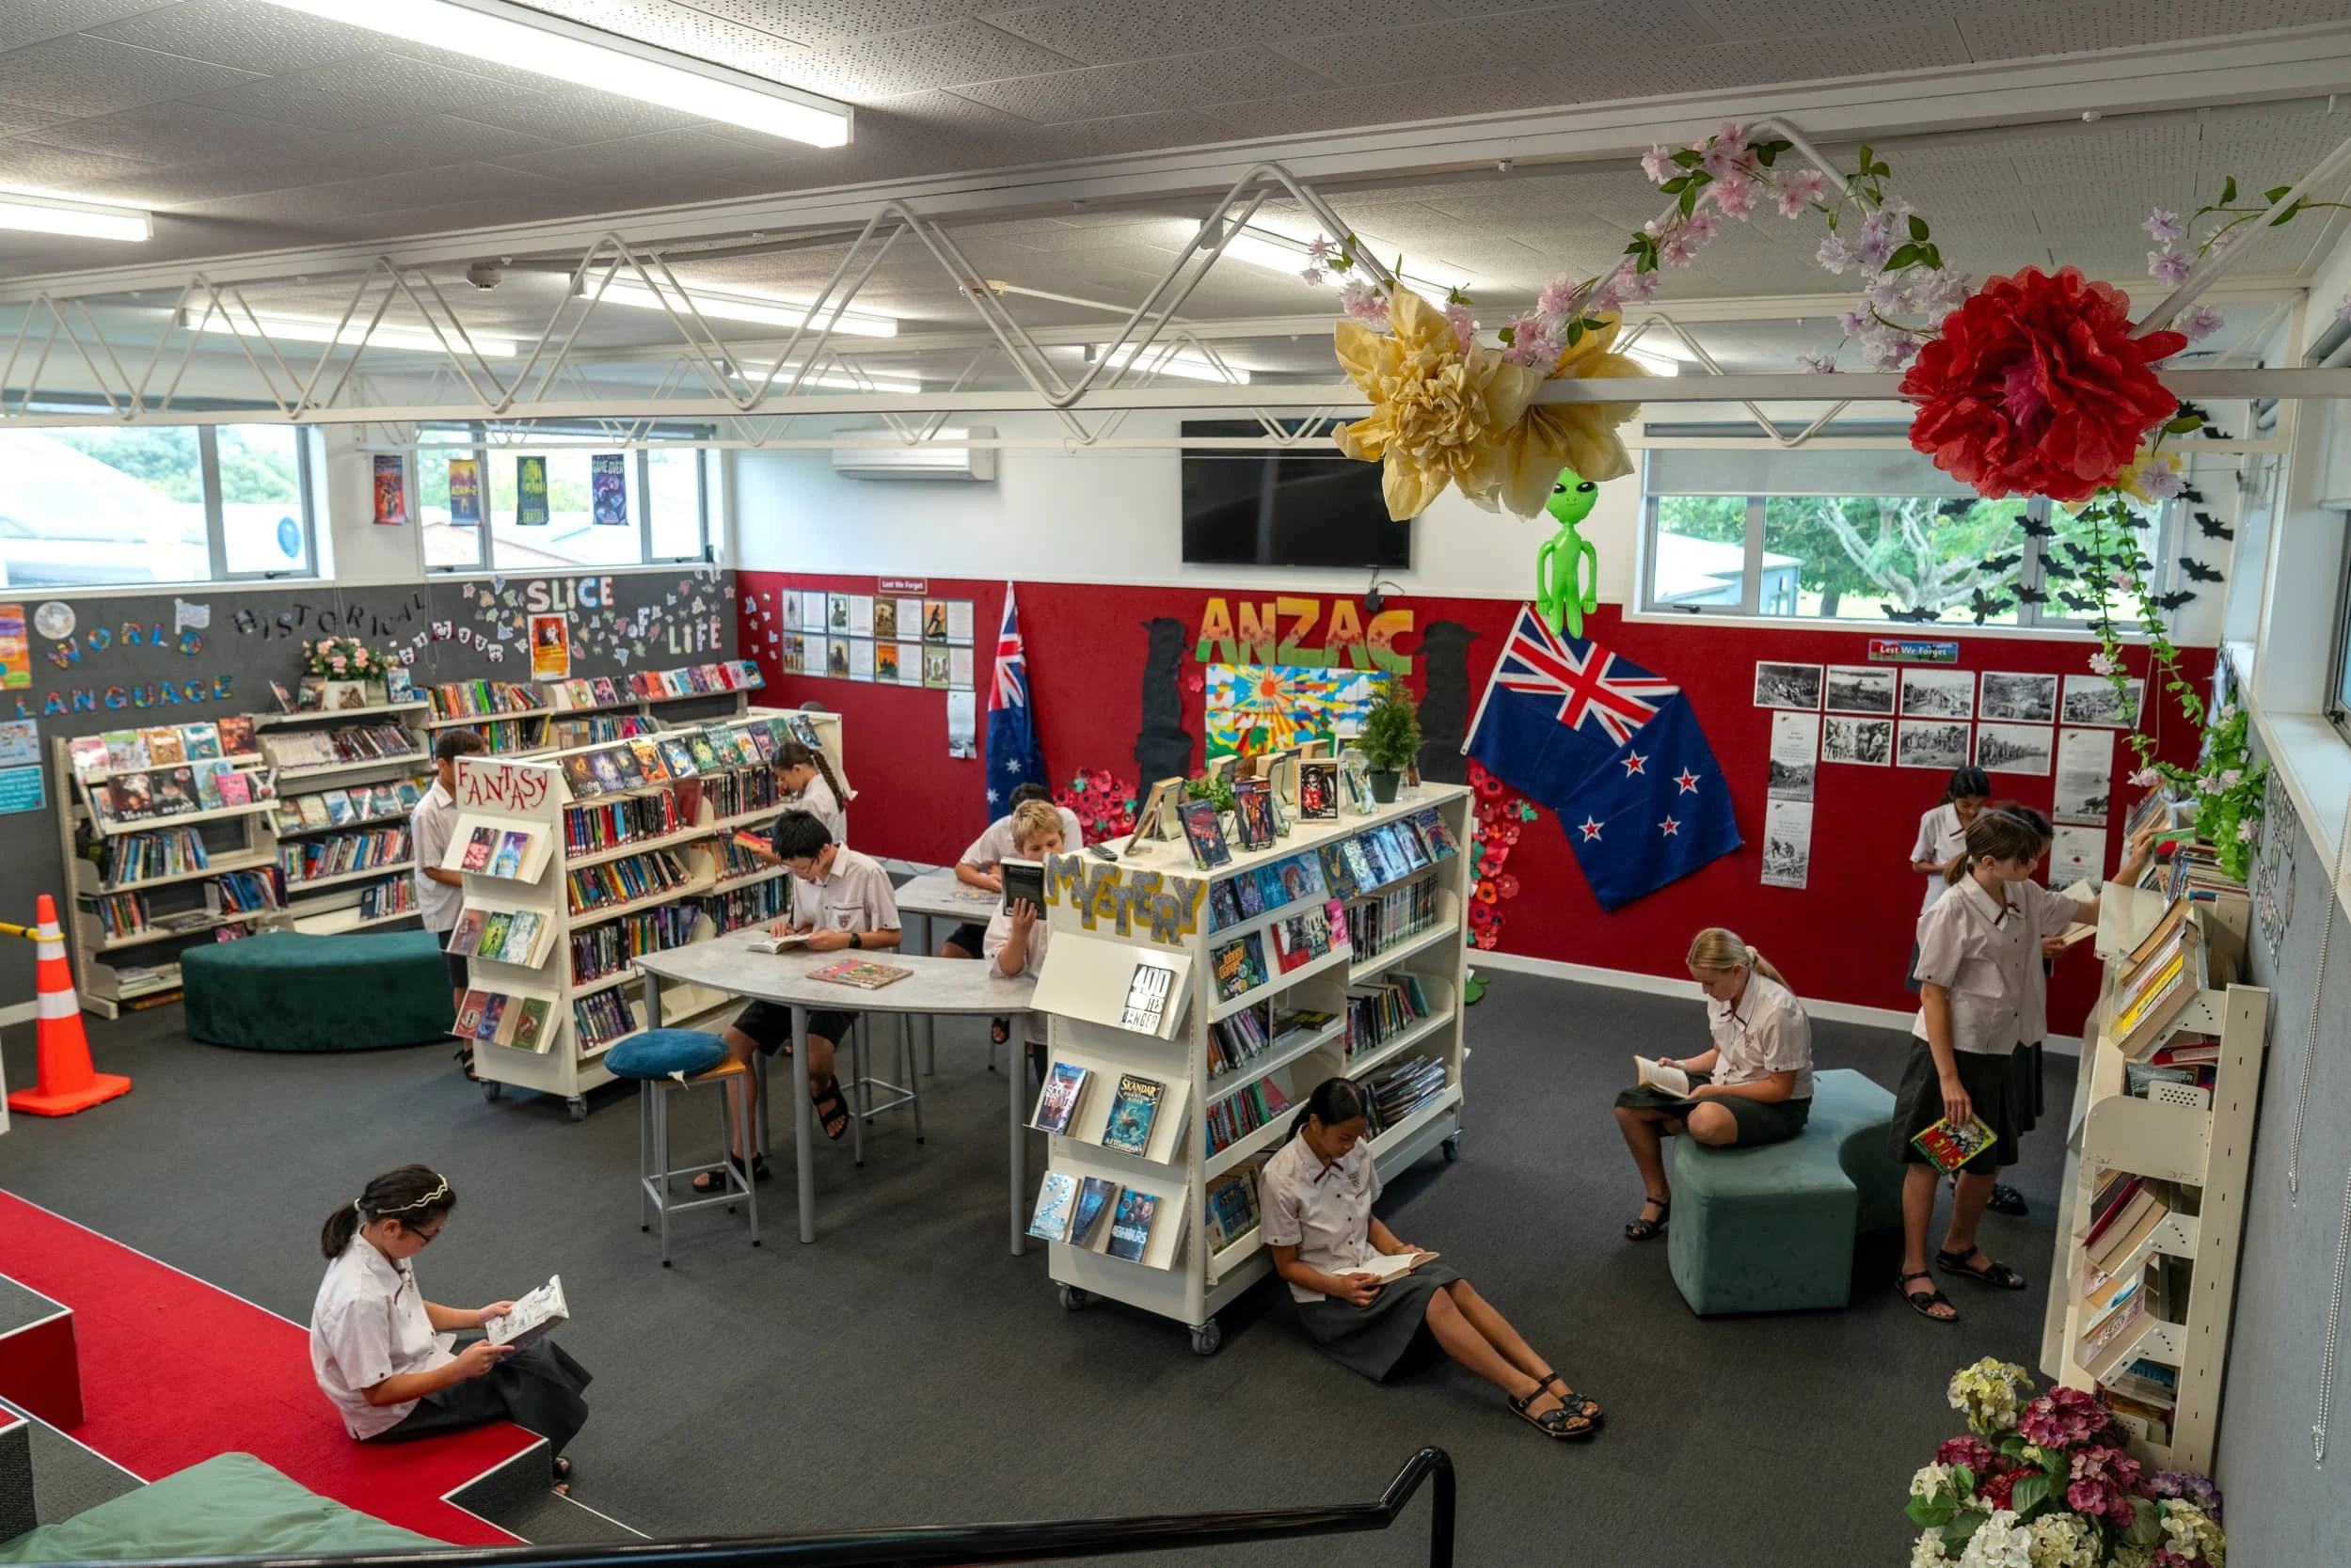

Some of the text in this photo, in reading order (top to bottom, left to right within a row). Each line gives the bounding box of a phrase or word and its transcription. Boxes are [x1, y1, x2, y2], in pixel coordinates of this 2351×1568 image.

[232, 594, 425, 640] HISTORICAL
[1196, 596, 1414, 675] ANZAC
[47, 622, 204, 670] WORLD
[1880, 645, 1946, 657] Lest We Forget
[15, 675, 233, 719] LANGUAGE
[458, 762, 549, 811] FANTASY
[1045, 853, 1207, 946] MYSTERY
[1132, 966, 1172, 999] 400
[1120, 1078, 1156, 1099] SKANDAR
